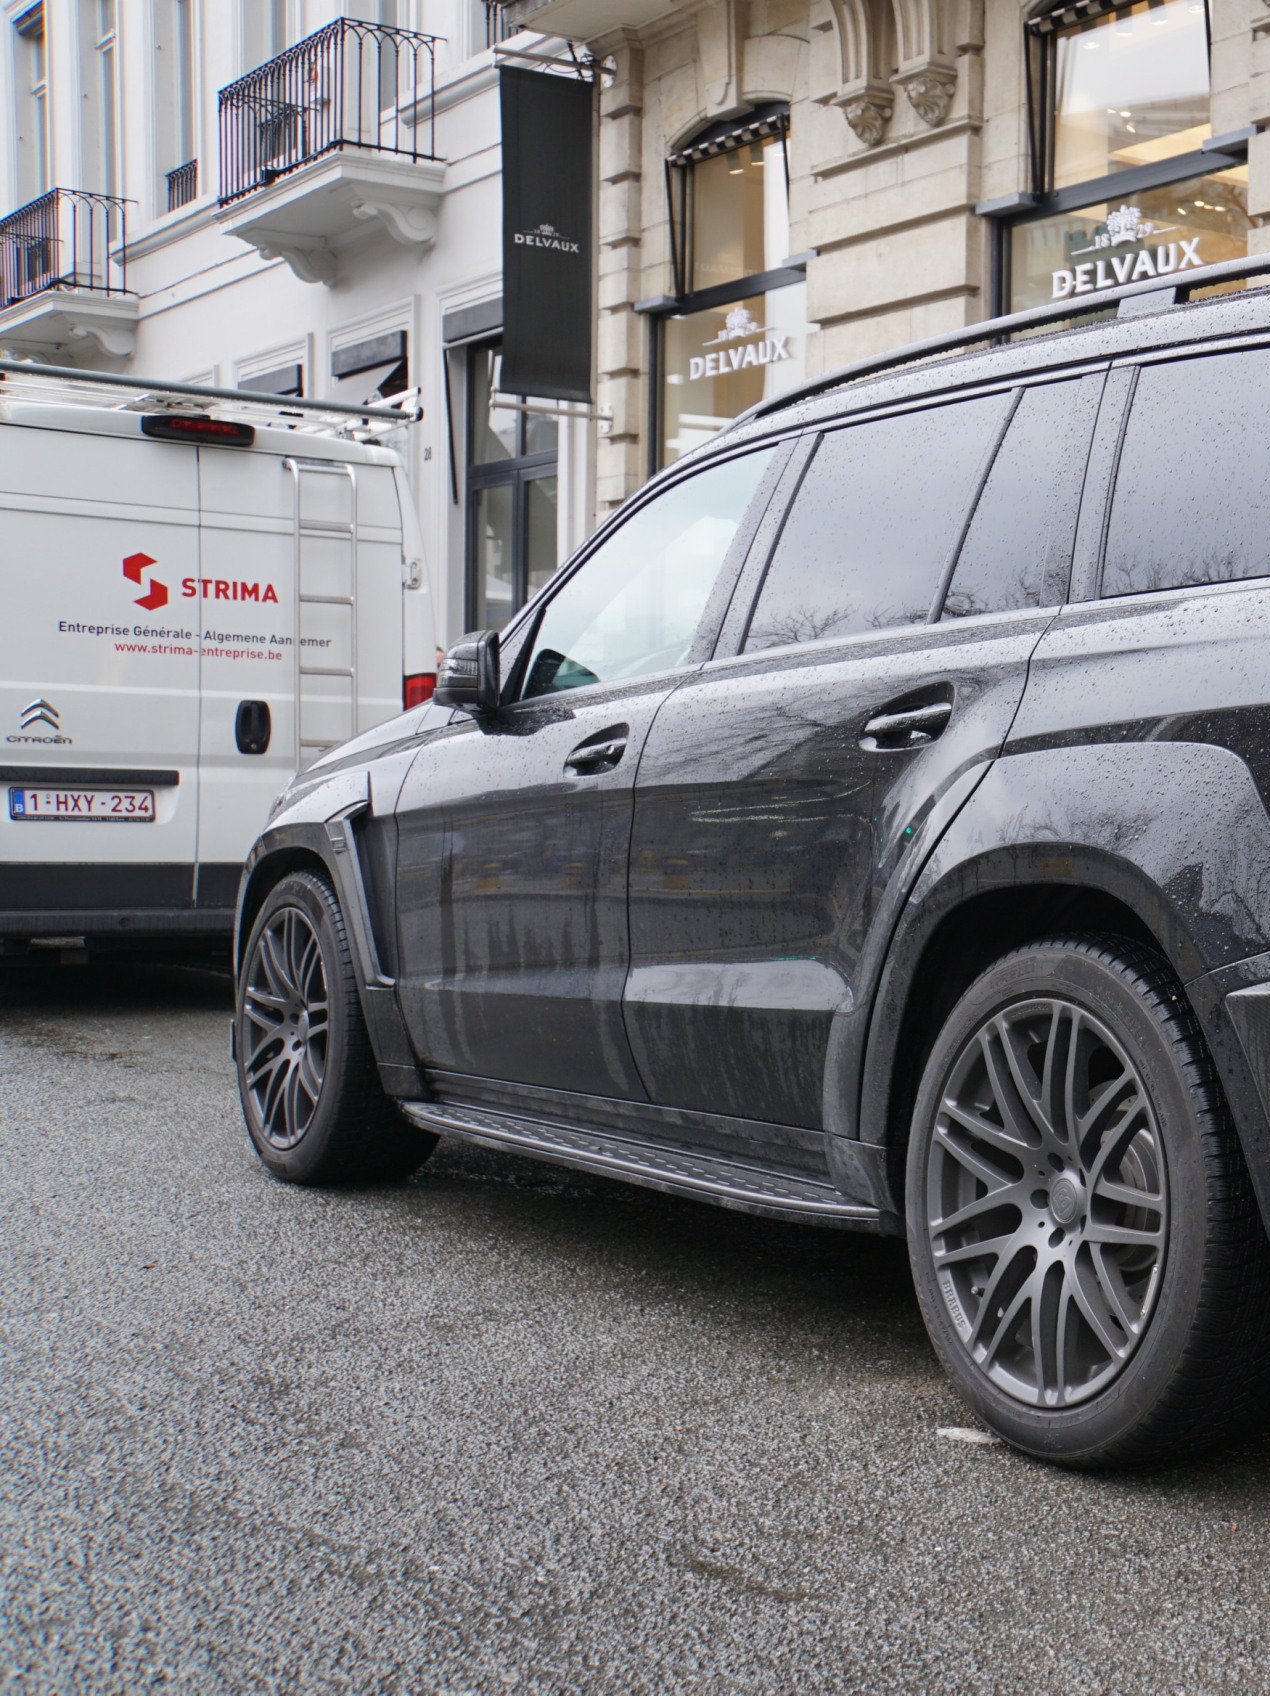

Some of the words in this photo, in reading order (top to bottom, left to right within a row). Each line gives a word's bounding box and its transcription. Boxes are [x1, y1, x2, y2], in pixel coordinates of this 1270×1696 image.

[514, 233, 580, 253] DELVAUX
[1052, 237, 1204, 299] DELVAUX
[689, 336, 790, 381] DELVAUX
[181, 577, 279, 604] STRIMA
[58, 621, 130, 636] Entreprise
[133, 624, 192, 641] Générale
[204, 629, 266, 646] Algemene
[114, 642, 283, 661] www.strima-entreprise.be
[15, 803, 24, 813] B
[942, 1280, 967, 1329] BRABUS
